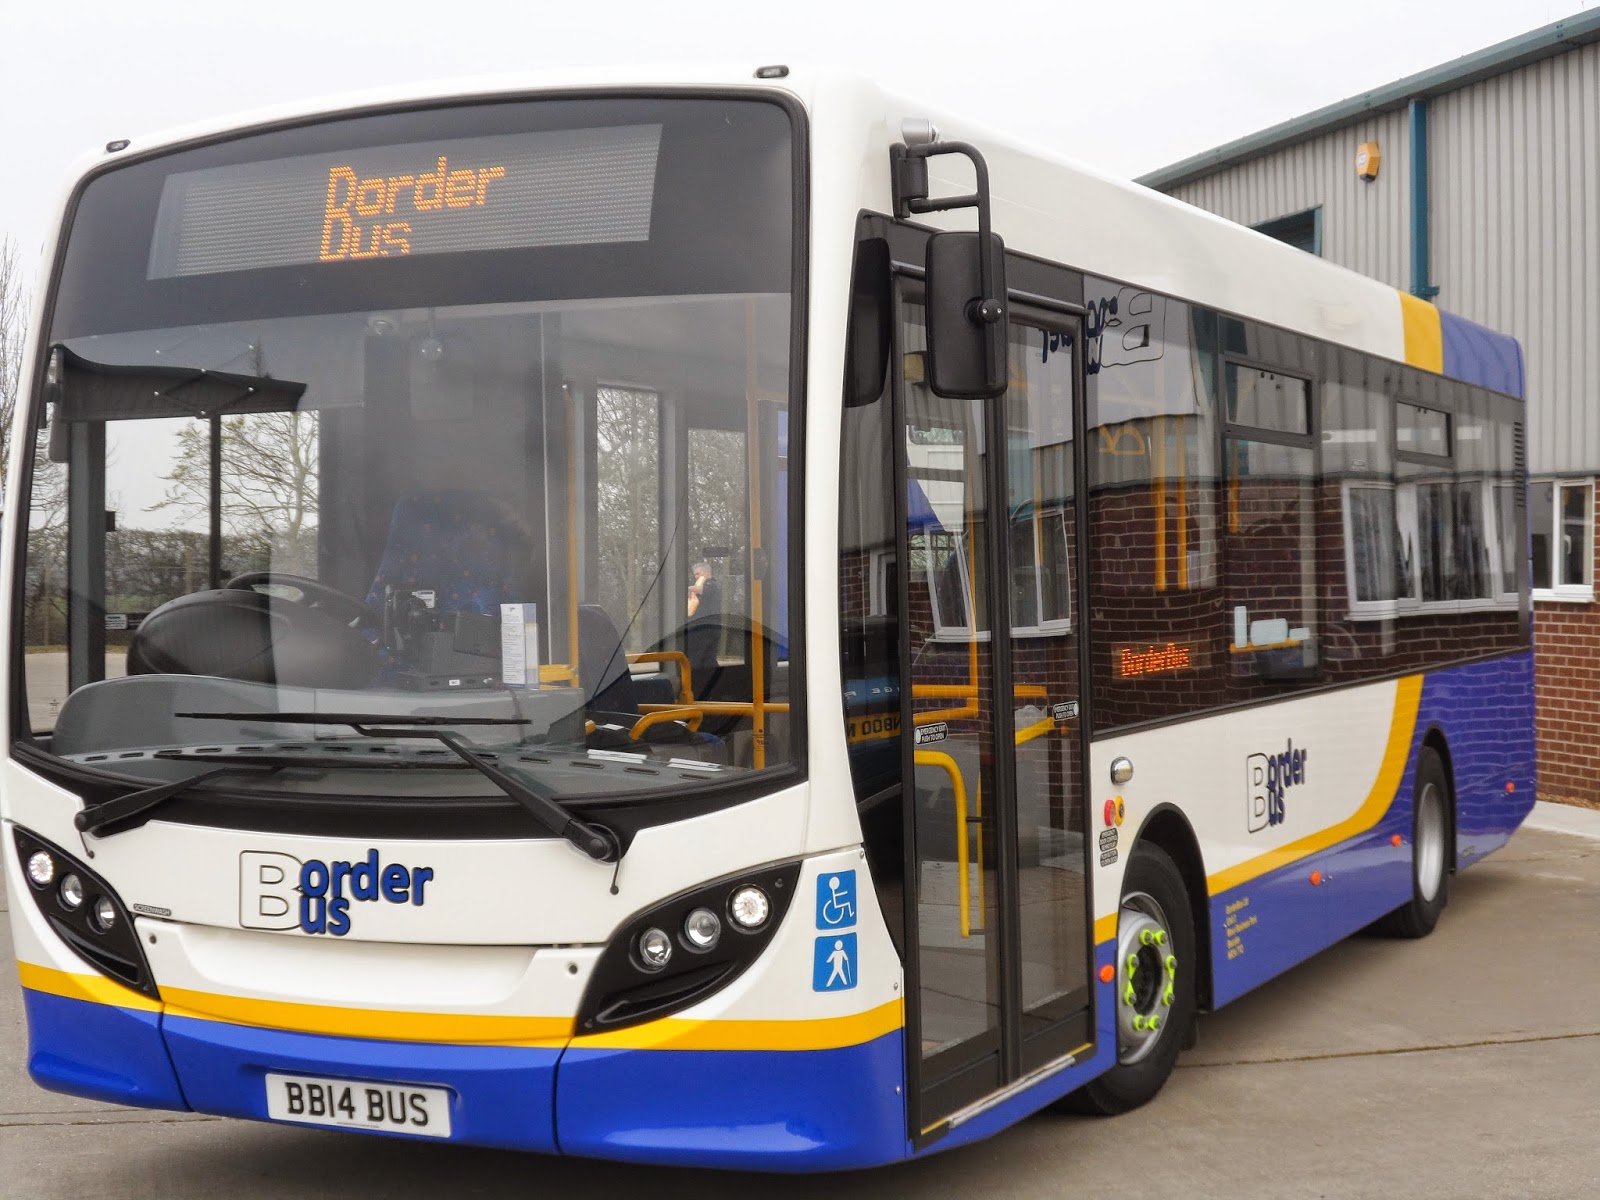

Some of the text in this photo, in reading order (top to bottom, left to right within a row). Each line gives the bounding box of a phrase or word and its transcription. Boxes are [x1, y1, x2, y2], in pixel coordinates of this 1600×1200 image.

[134, 903, 171, 916] SCREENWASH
[239, 848, 433, 930] Border
[285, 1082, 428, 1127] BB14 BUS
